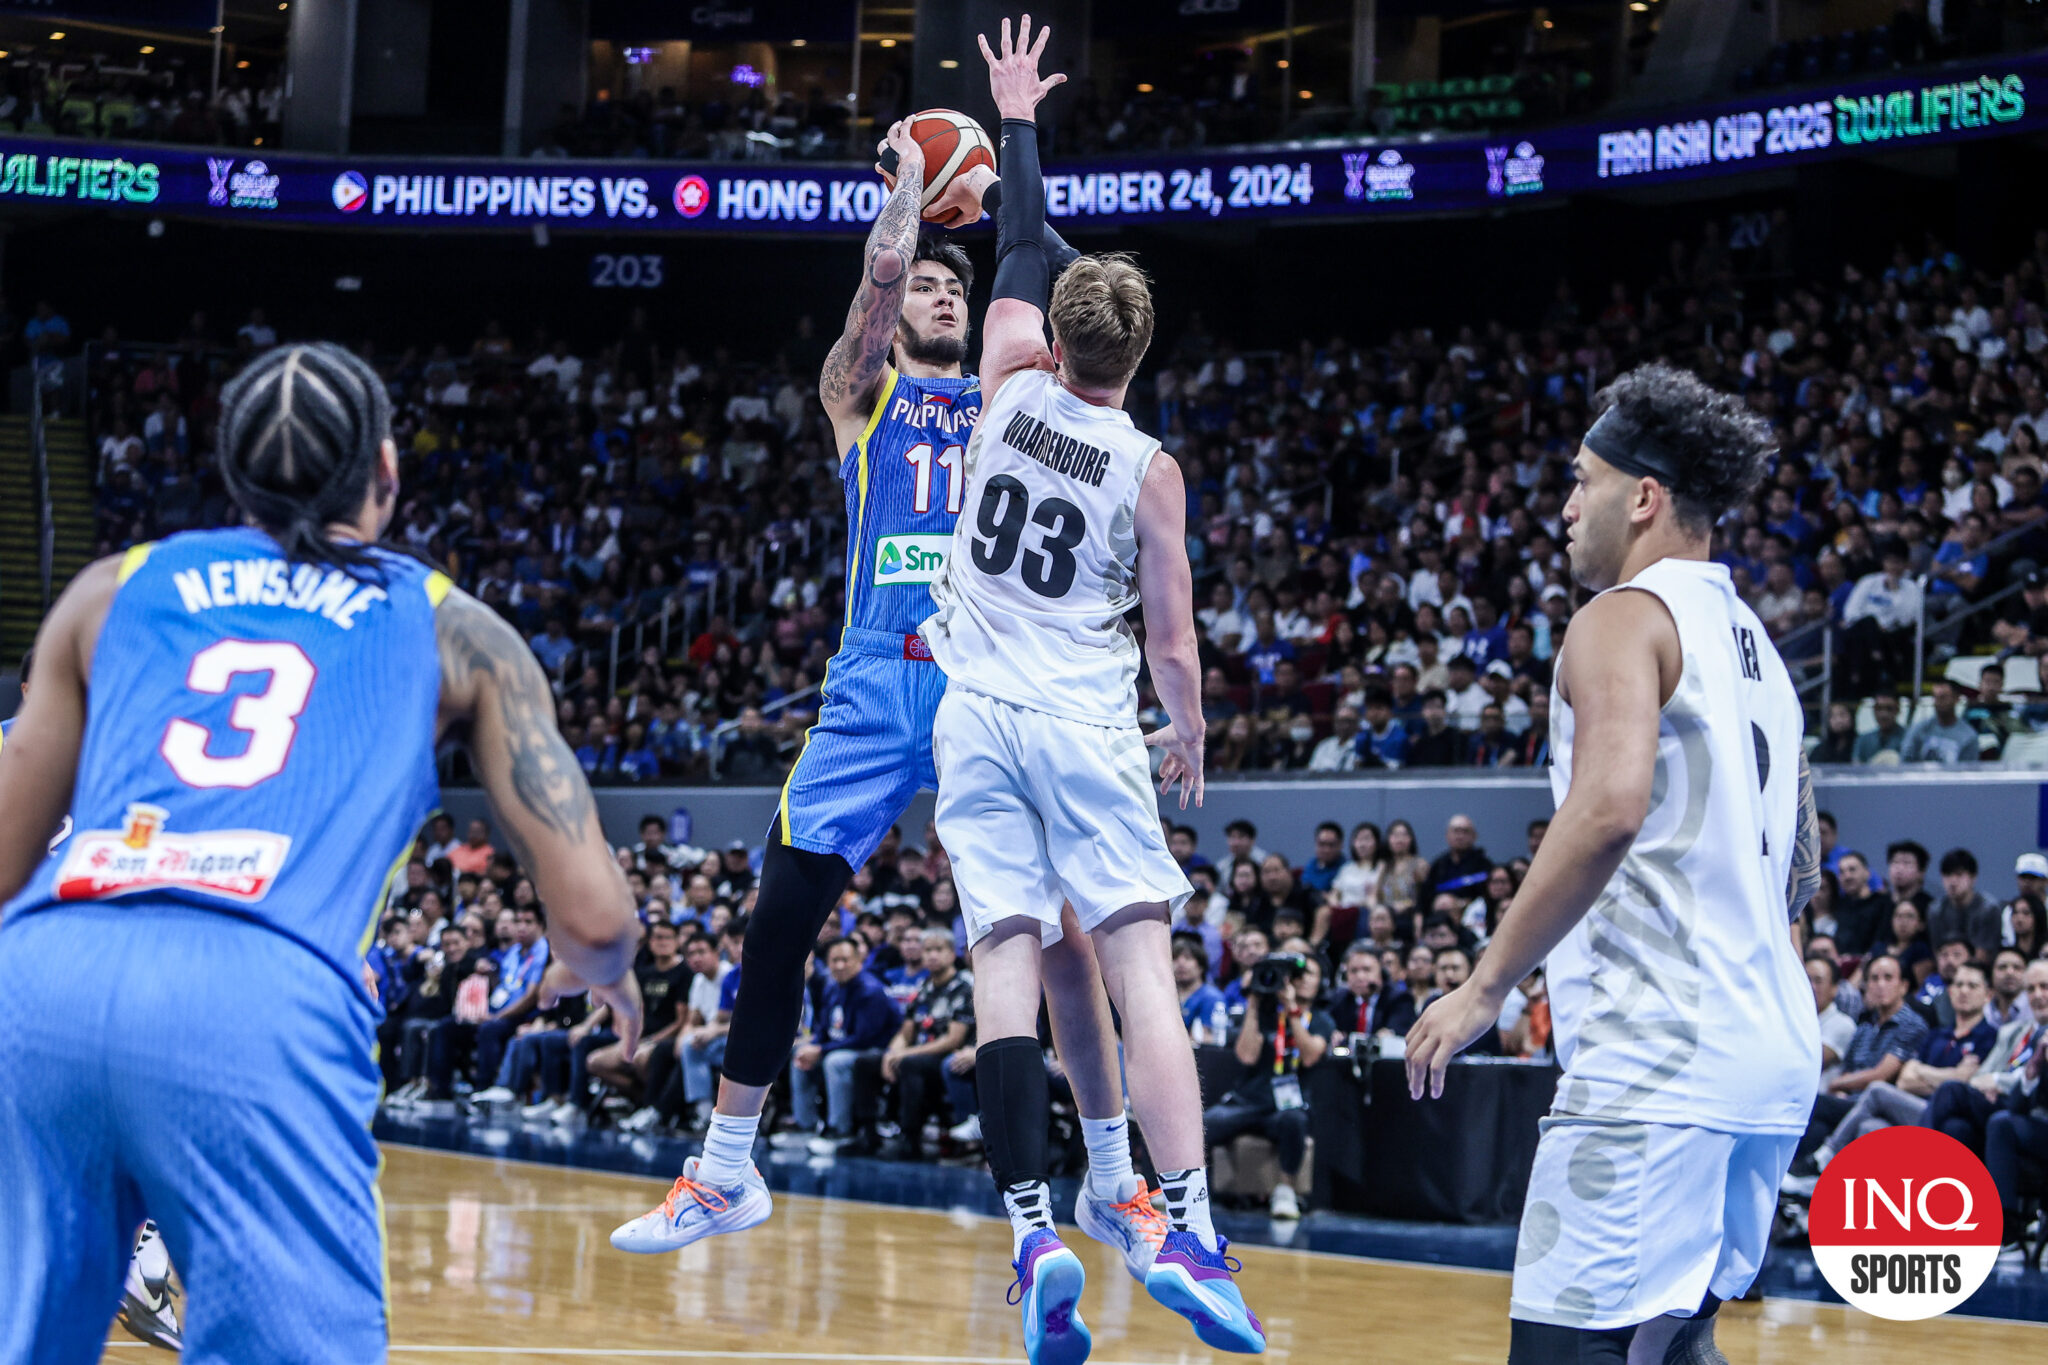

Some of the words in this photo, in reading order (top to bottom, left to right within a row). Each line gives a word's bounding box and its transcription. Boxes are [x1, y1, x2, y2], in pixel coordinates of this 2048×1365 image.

[1598, 128, 1653, 177] FIBA
[1654, 119, 1711, 170] ASIA
[1713, 111, 1764, 161] CUP
[1766, 101, 1833, 154] 2025
[1834, 74, 2025, 144] QUALIFIERS
[0, 153, 160, 203] ALIFIERS
[372, 175, 596, 217] PHILIPPINES
[601, 177, 658, 218] VS.
[717, 179, 823, 221] HONG
[829, 181, 891, 222] KO
[1043, 171, 1164, 216] EMBER
[1169, 168, 1223, 216] 24,
[1227, 162, 1313, 207] 2024
[1729, 211, 1770, 249] 20
[593, 255, 662, 287] 203
[905, 443, 966, 514] 11
[971, 473, 1086, 598] 93
[160, 637, 319, 789] 3
